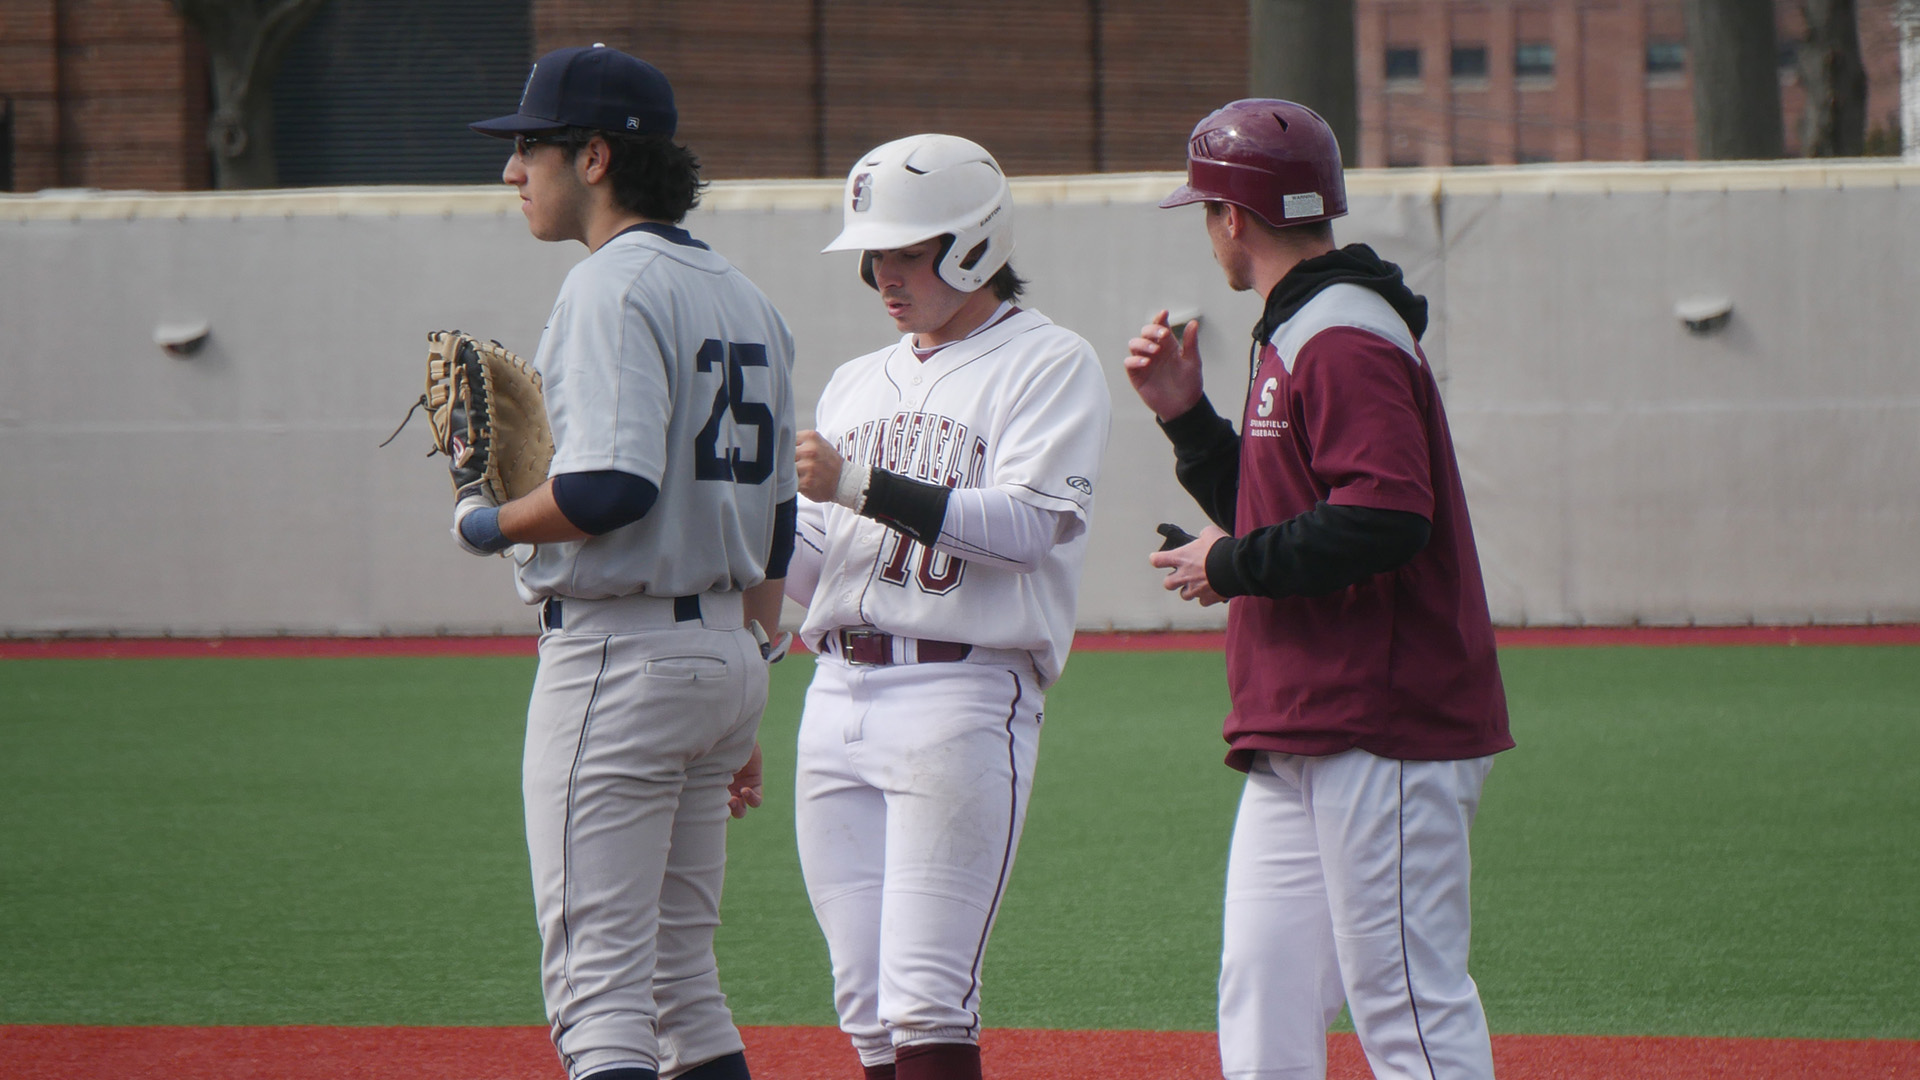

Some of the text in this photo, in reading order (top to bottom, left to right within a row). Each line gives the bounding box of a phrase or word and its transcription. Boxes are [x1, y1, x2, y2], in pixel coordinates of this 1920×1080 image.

[852, 172, 873, 212] S
[979, 204, 1002, 228] EASTON
[695, 338, 775, 485] 25
[1257, 377, 1278, 417] S
